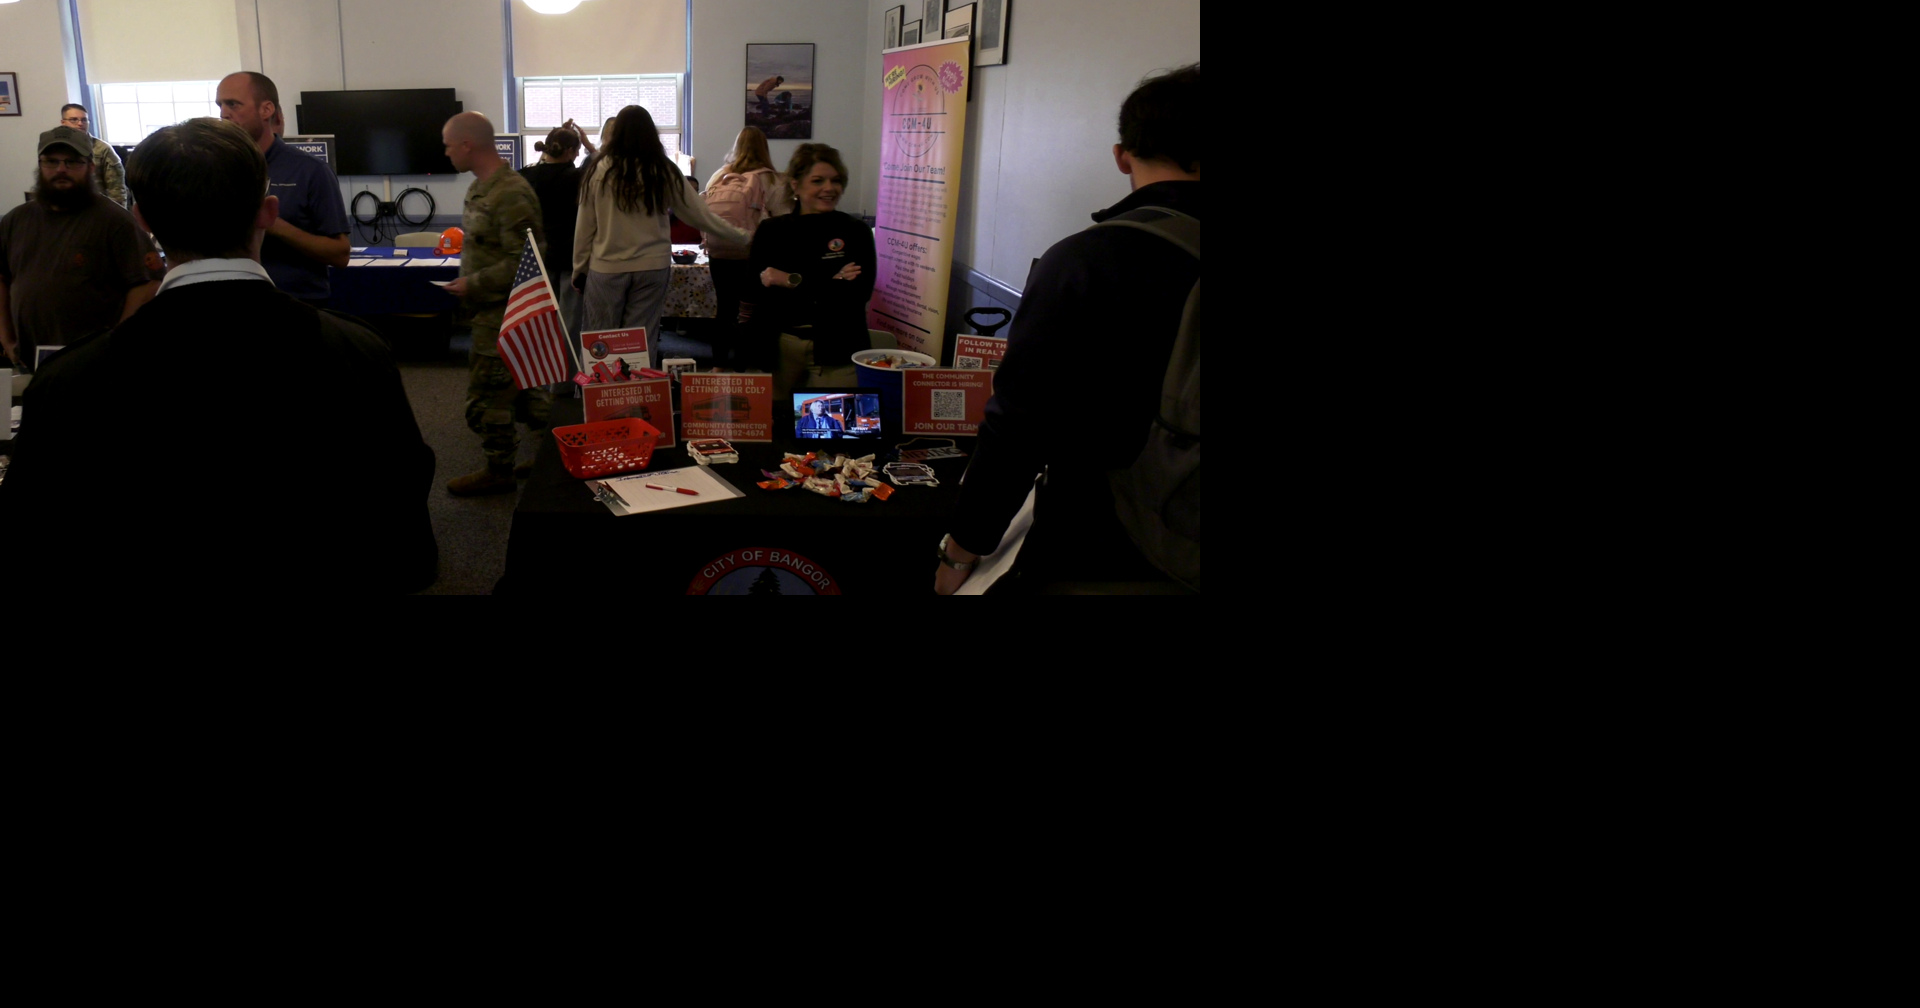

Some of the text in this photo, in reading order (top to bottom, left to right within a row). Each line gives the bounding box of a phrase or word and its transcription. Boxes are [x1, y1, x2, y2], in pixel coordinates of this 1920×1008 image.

[902, 117, 931, 129] CCM-4U
[900, 163, 912, 172] Join
[914, 164, 926, 173] Our
[928, 165, 946, 175] Team!
[959, 338, 993, 348] FOLLOW
[976, 348, 998, 356] REAL
[692, 378, 754, 386] INTERESTED IN
[601, 385, 652, 398] INTERESTED IN
[685, 386, 719, 394] GETTING
[721, 386, 743, 394] YOUR
[596, 393, 661, 407] GETTING YOUR CDL?
[726, 422, 767, 430] CONNECTOR
[914, 422, 934, 430] JOIN
[936, 422, 954, 430] OUR
[707, 429, 727, 437] (207)
[728, 429, 764, 437] 992-4674
[703, 550, 831, 590] CITY OF BANGOR
